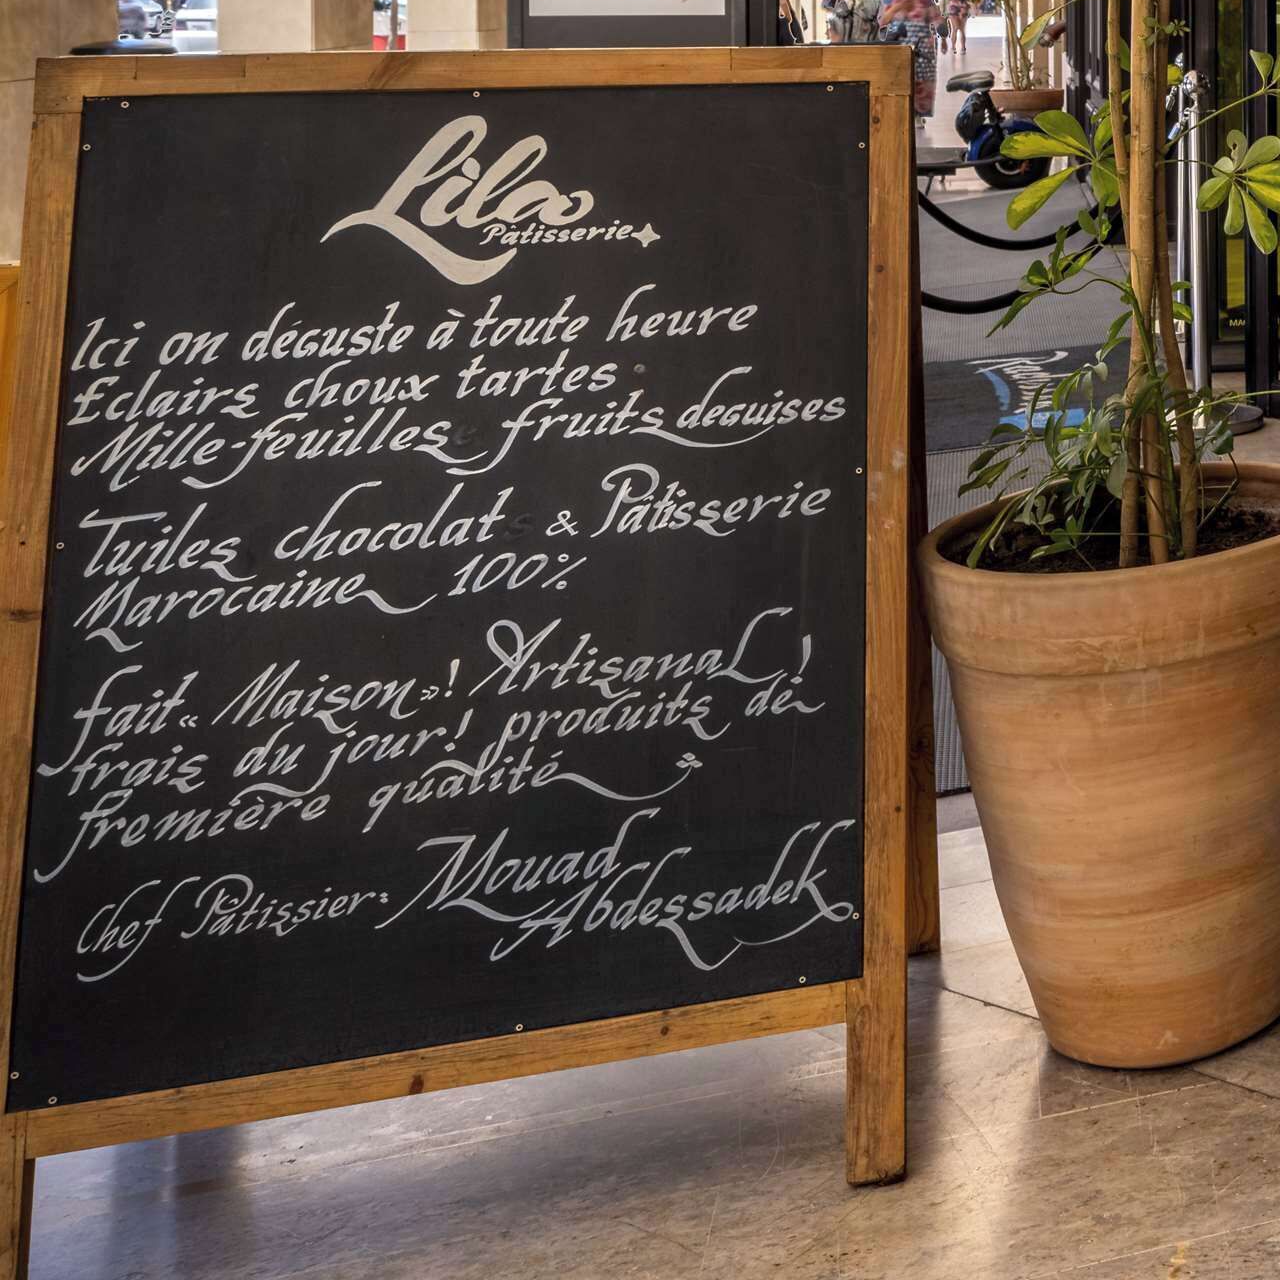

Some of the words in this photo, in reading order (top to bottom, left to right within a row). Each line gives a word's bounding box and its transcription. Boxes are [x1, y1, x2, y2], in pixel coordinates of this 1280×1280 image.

[320, 115, 594, 285] Lila
[479, 219, 634, 246] Pâtisserie
[71, 317, 147, 372] Ici
[159, 330, 229, 366] on
[426, 308, 465, 351] à
[469, 294, 590, 348] toute
[605, 283, 758, 343] heure
[66, 369, 260, 427] Eclairs
[284, 359, 440, 409] choux
[456, 349, 618, 400] tartes
[71, 406, 488, 492] Mille-feuilles
[446, 390, 700, 475] fruits
[79, 502, 258, 583] Tuiles
[273, 481, 514, 563] chocolat
[546, 510, 579, 537] &
[73, 569, 438, 653] Marocaine
[447, 552, 587, 597] 100%
[37, 664, 199, 776] fait
[68, 743, 209, 795] frais
[233, 722, 306, 778] du
[476, 682, 731, 775] produits
[744, 670, 826, 717] de
[362, 747, 690, 833] qualité
[77, 876, 201, 984] Chef
[375, 806, 662, 930] Mouad
